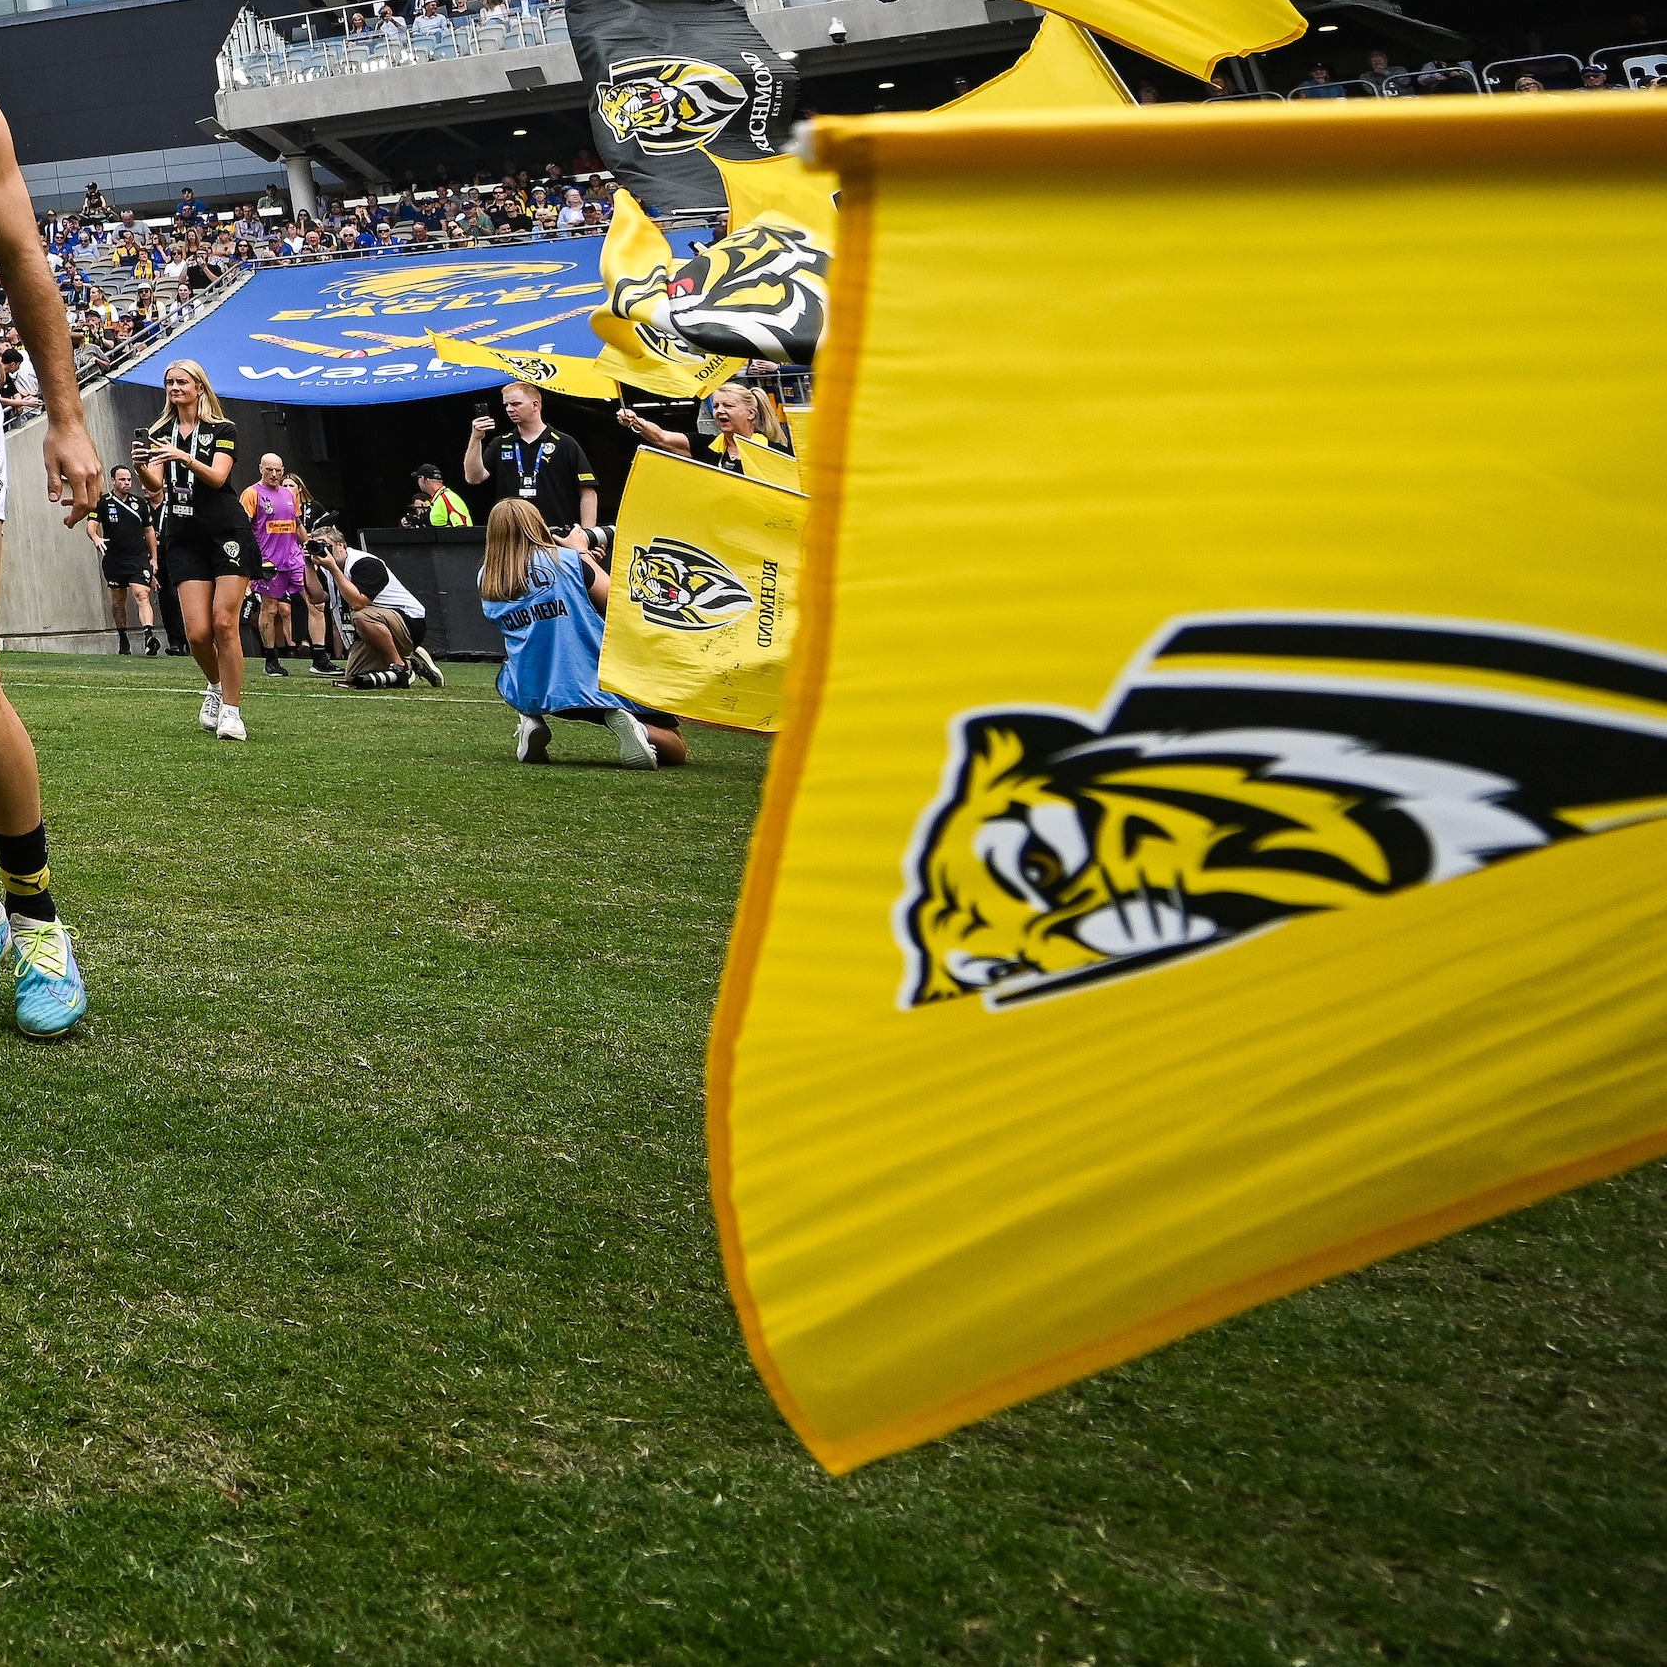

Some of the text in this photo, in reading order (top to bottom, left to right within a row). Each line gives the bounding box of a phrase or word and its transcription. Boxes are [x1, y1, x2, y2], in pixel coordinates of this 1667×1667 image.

[740, 52, 775, 153] RICHMOND
[771, 101, 782, 117] EST
[268, 282, 605, 323] EAGLES
[325, 281, 561, 311] WEST COAST
[299, 370, 469, 388] FOUNDATION
[501, 599, 568, 632] CLUB MEDIA
